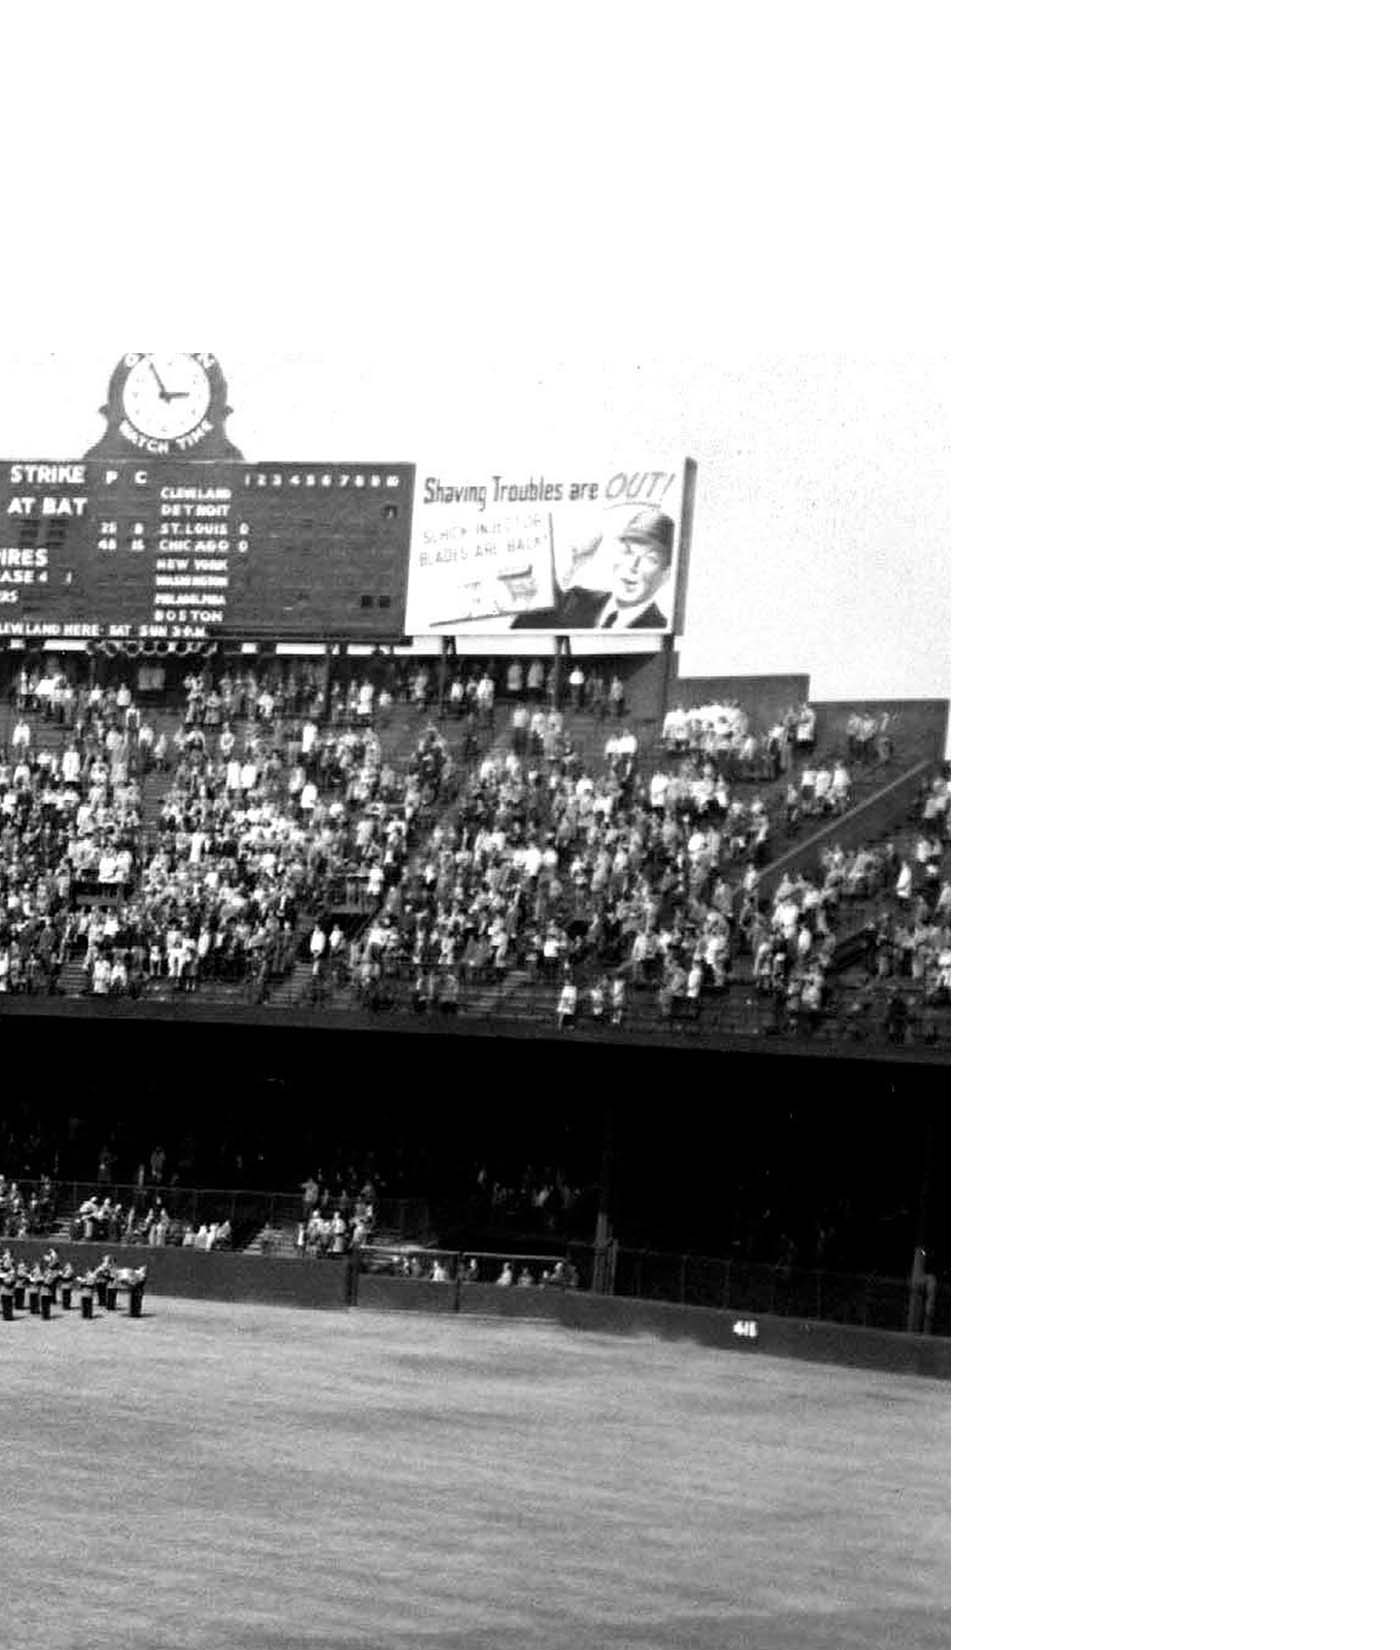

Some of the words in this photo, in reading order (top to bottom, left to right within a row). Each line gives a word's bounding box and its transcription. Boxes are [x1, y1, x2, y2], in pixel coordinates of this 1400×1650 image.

[10, 465, 86, 483] STRIKE
[105, 470, 118, 484] P
[134, 470, 148, 484] C
[423, 476, 487, 512] Shaving
[492, 475, 563, 502] Troubles
[568, 481, 599, 501] are
[604, 471, 677, 502] OUT!
[7, 497, 36, 515] AT
[42, 497, 88, 515] BAT
[160, 504, 231, 517] DETROIT
[185, 522, 228, 535] LOUIS
[159, 539, 230, 553] CHICAGO
[154, 610, 224, 622] BOSTON
[139, 625, 168, 637] SUN
